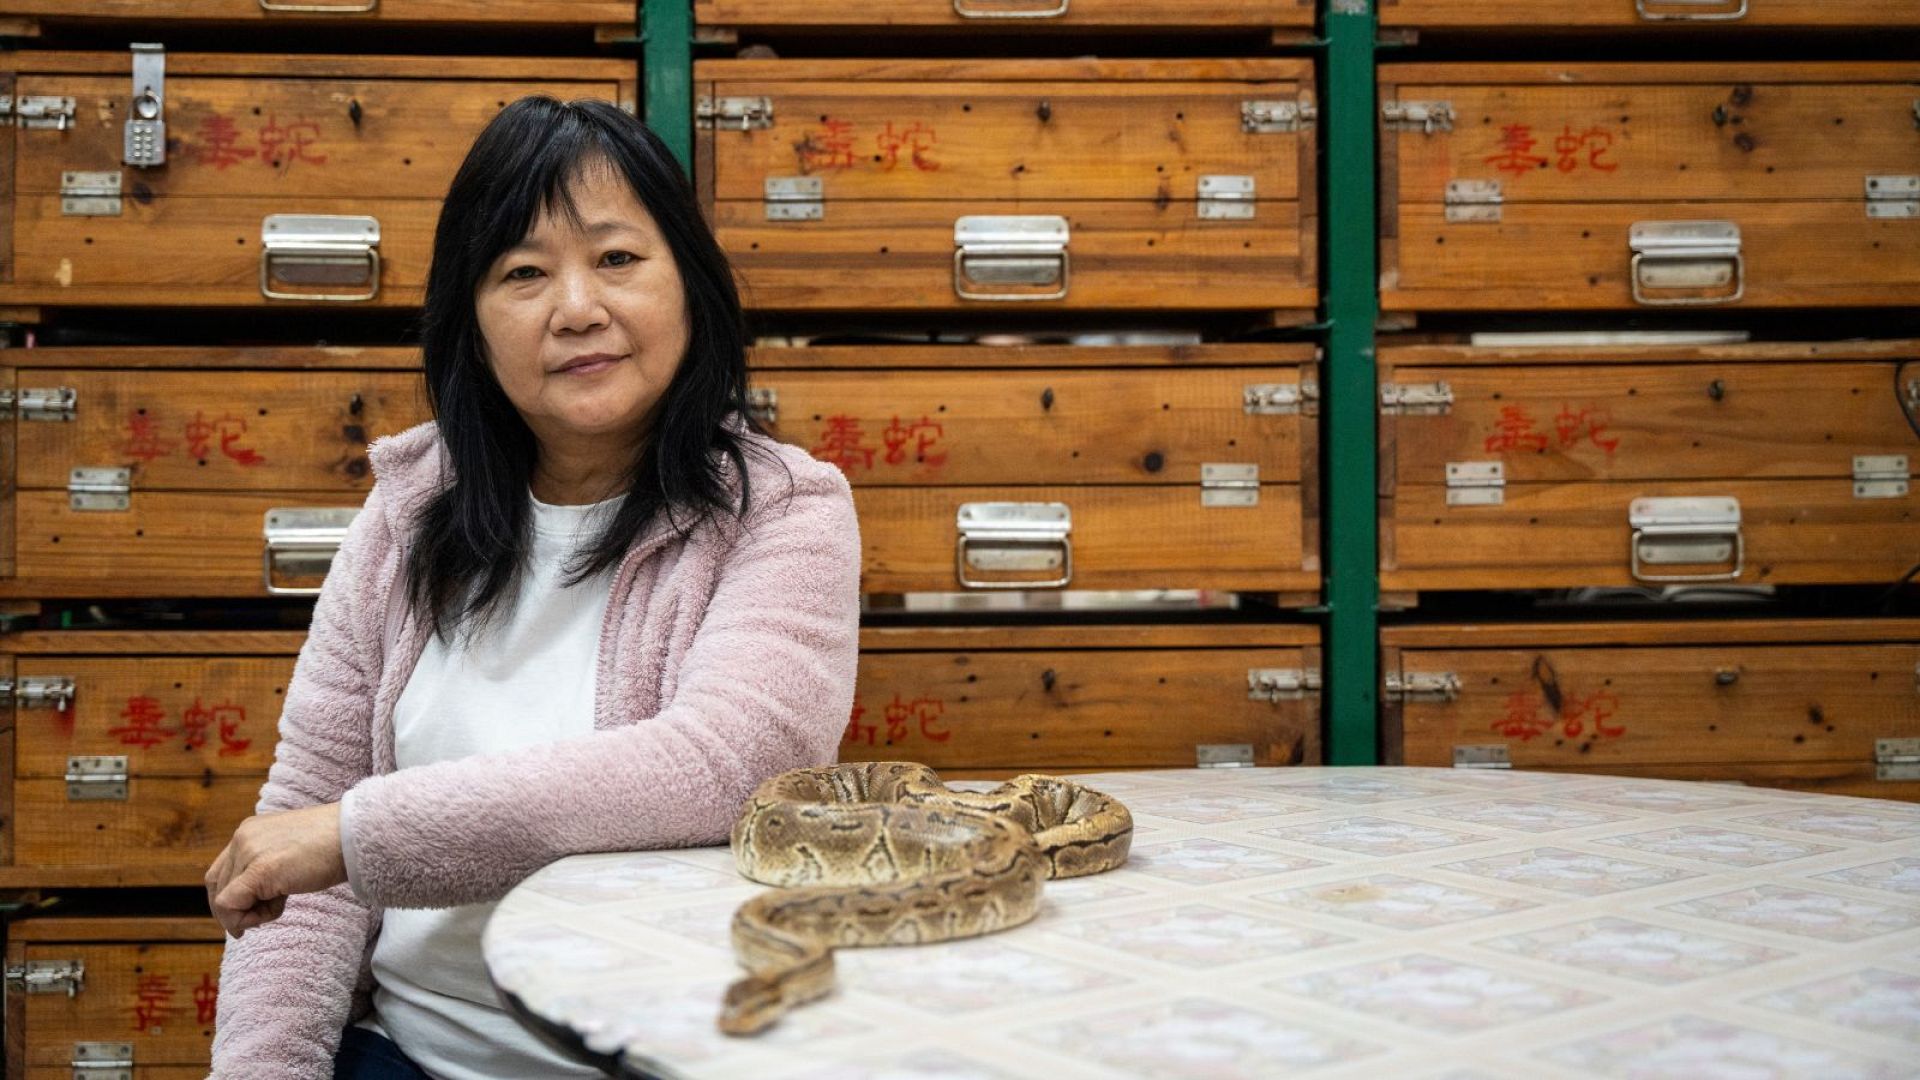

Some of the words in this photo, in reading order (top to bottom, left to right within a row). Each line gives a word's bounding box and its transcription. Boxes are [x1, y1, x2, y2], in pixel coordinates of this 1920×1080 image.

[196, 115, 328, 169] 毒蛇
[1483, 123, 1620, 176] 毒蛇
[117, 409, 266, 467] 毒蛇
[812, 413, 949, 470] 毒蛇
[1483, 404, 1620, 454] 毒蛇
[109, 695, 252, 757] 毒蛇
[1490, 689, 1627, 741] 毒蛇
